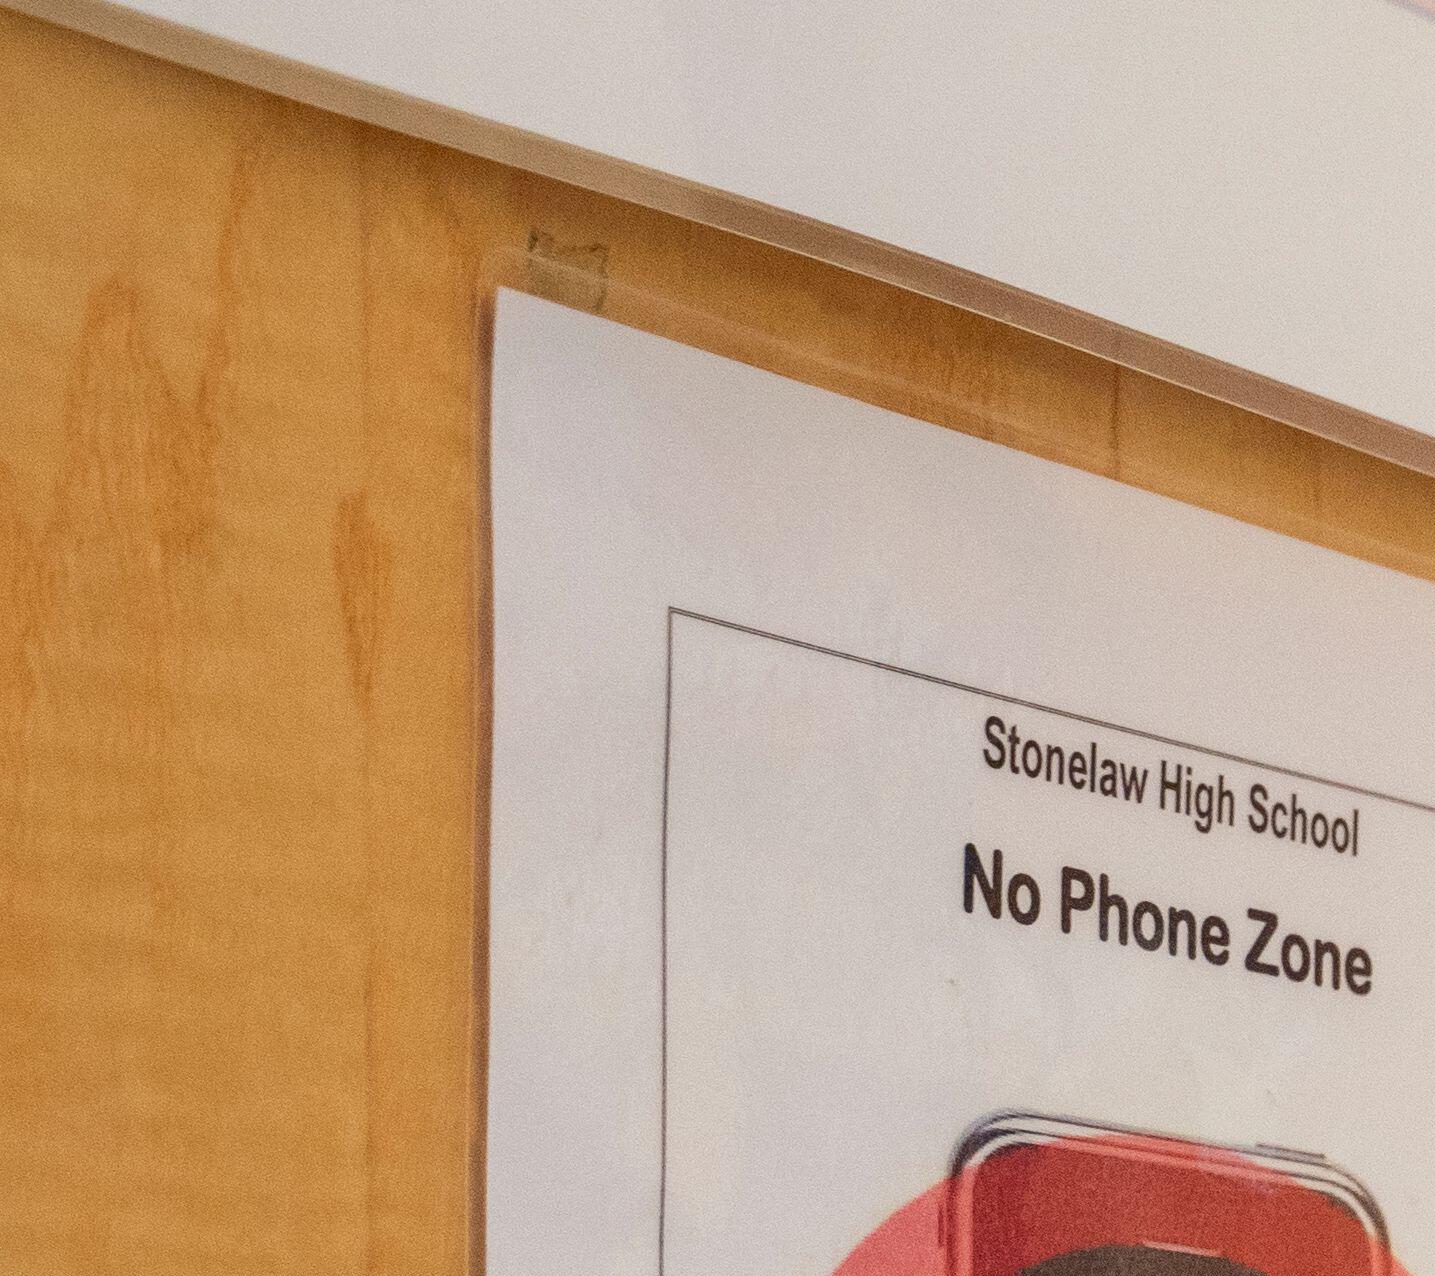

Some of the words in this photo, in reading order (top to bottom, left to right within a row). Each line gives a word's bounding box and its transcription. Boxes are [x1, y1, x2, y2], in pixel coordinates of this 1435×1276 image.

[982, 715, 1149, 804] Stonelaw
[1159, 760, 1235, 834] High
[1247, 783, 1360, 856] School
[962, 842, 1041, 926] No
[1060, 865, 1231, 967] Phone
[1243, 907, 1374, 997] Zone
